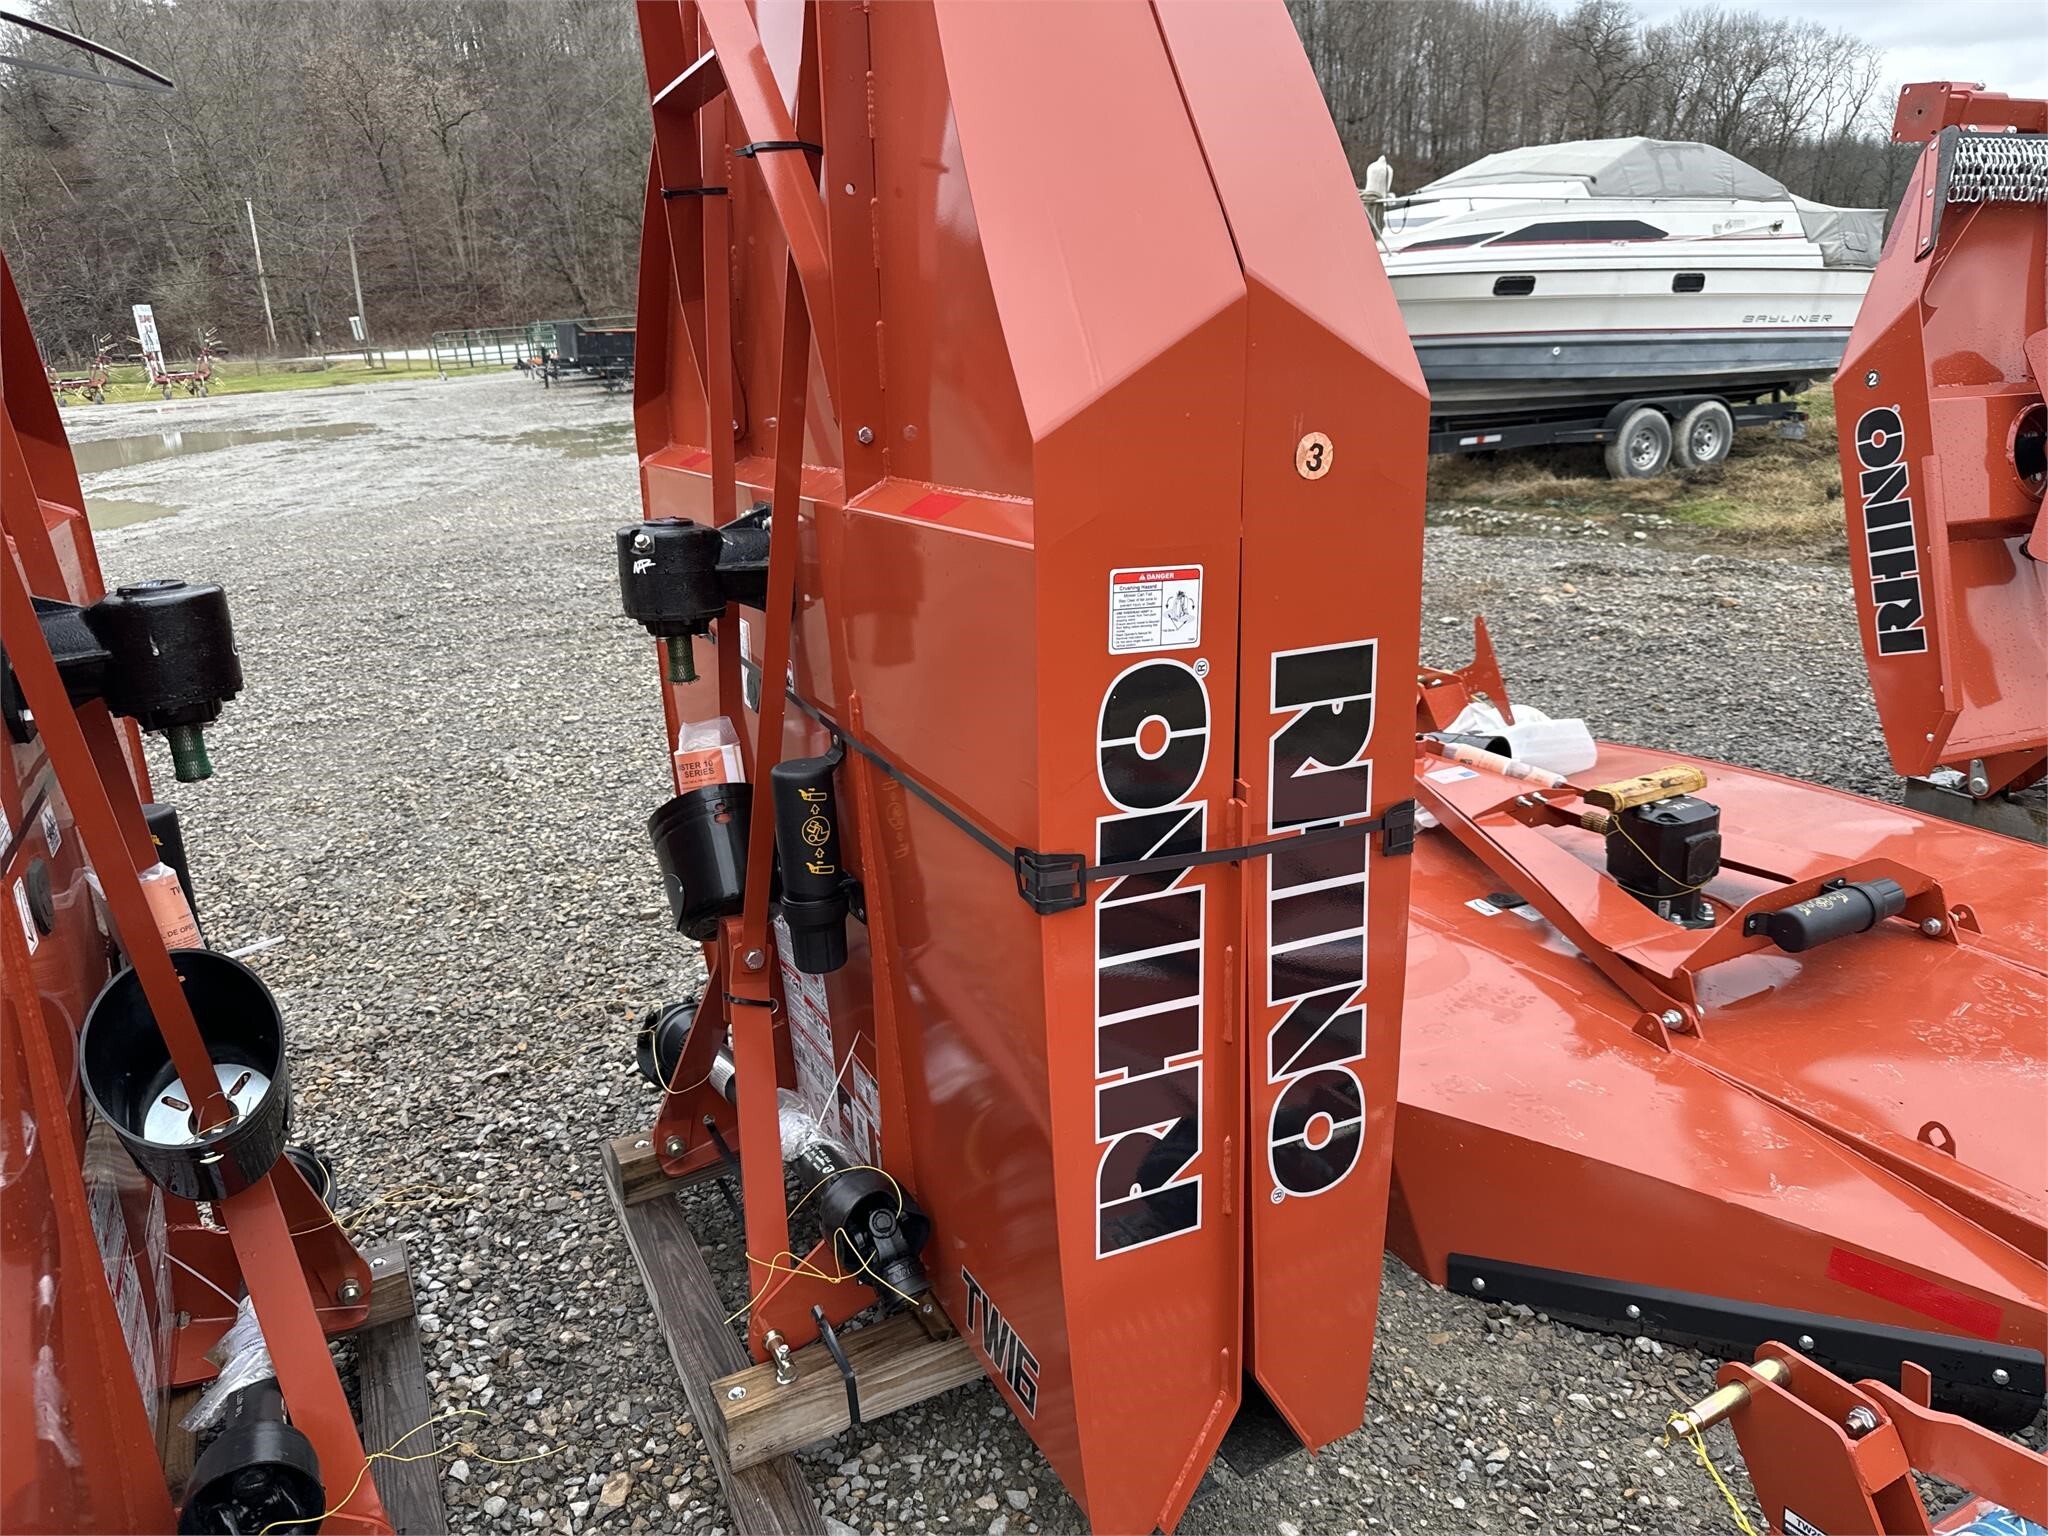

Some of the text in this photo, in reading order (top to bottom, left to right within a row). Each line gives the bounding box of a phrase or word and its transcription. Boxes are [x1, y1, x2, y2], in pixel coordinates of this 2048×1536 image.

[1742, 314, 1833, 323] BAYLINER
[1868, 373, 1877, 386] 2
[1306, 443, 1324, 471] 3
[1855, 406, 1928, 656] RHINO
[1146, 572, 1175, 581] DANGER
[703, 760, 714, 768] 10
[684, 767, 715, 779] SERIES
[1267, 638, 1378, 1198] RHINO
[1095, 657, 1212, 1260] RHINO
